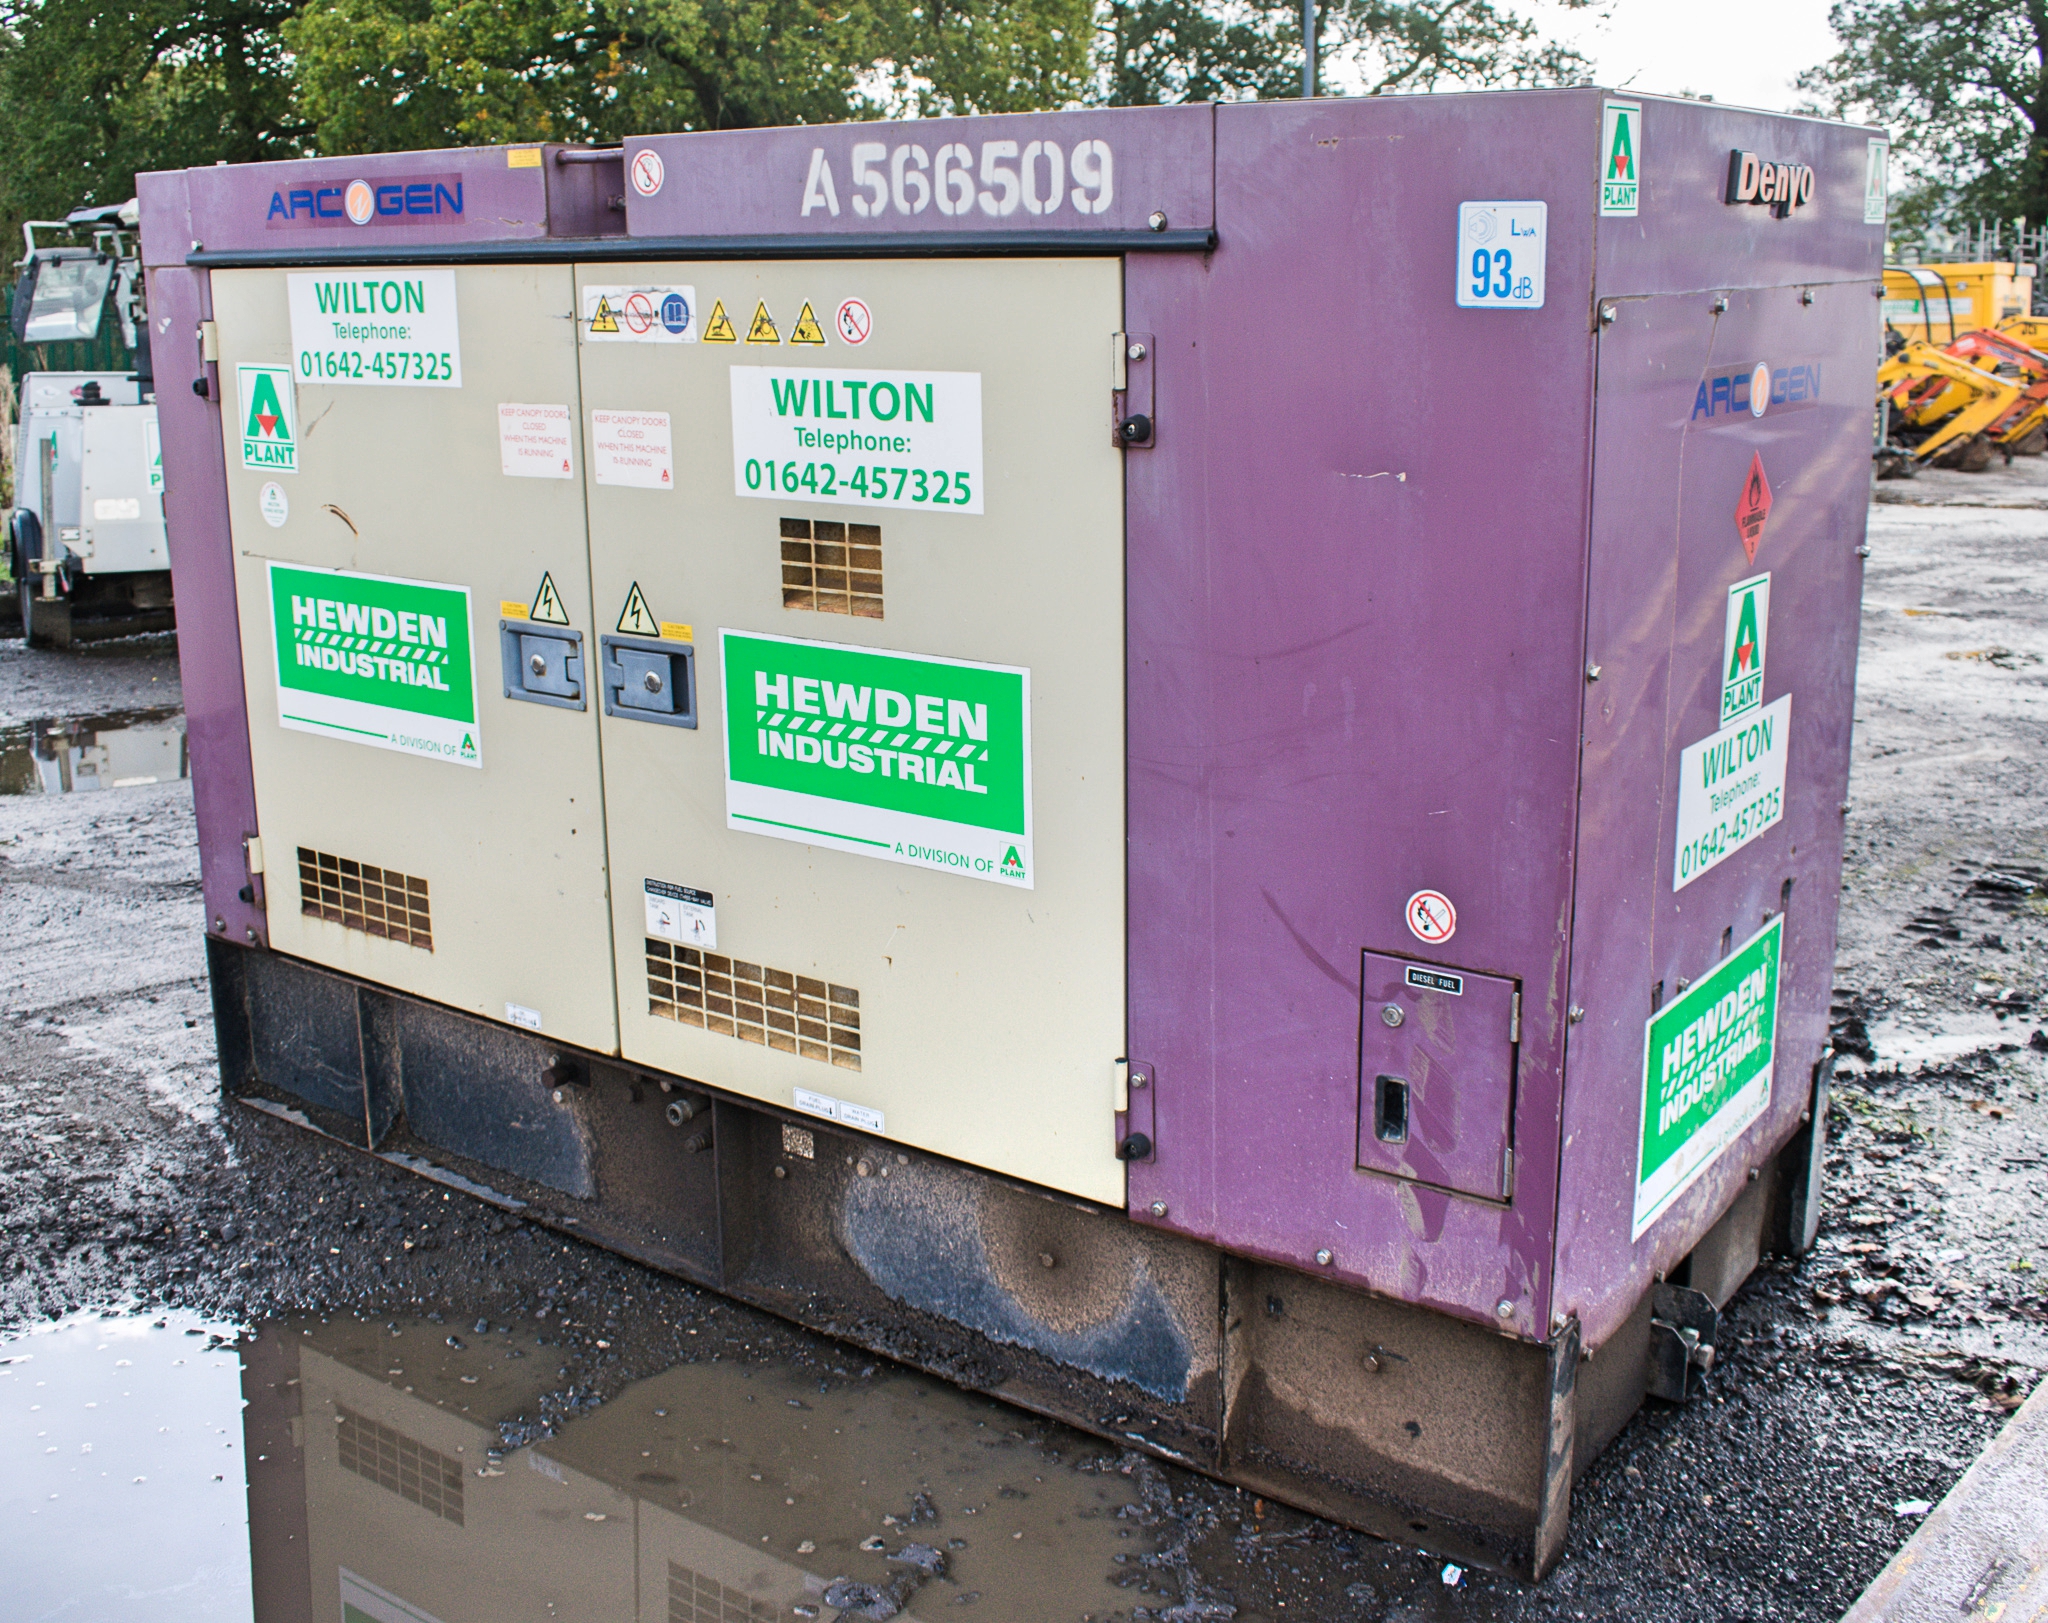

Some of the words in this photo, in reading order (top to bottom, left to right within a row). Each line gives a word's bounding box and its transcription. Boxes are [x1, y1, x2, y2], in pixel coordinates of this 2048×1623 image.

[1607, 113, 1635, 179] A
[801, 148, 840, 217] A
[851, 139, 1114, 217] 566509
[1733, 151, 1815, 217] Denyo
[1604, 187, 1636, 206] PLANT
[1472, 248, 1512, 298] 93
[1513, 277, 1533, 299] dB
[315, 281, 425, 314] WILTON
[332, 322, 411, 343] Telephone:
[301, 351, 453, 380] 01642-457325
[247, 374, 290, 440] A
[501, 408, 516, 417] KEEP
[517, 409, 542, 418] CANOPY
[543, 410, 567, 419] DOORS
[771, 378, 934, 423] WILTON
[522, 422, 547, 431] CLOSED
[595, 415, 610, 424] KEEP
[612, 416, 640, 425] CANOPY
[642, 417, 667, 427] DOORS
[617, 429, 644, 439] CLOSED
[244, 443, 295, 465] PLANT
[504, 434, 523, 443] WHEN
[523, 435, 537, 444] THIS
[538, 436, 567, 446] MACHINE
[524, 448, 554, 458] RUNNING
[597, 441, 618, 451] WHEN
[619, 443, 634, 452] THIS
[635, 444, 667, 455] MACHINE
[794, 426, 911, 454] Telephone:
[619, 456, 652, 467] RUNNING
[745, 459, 971, 505] 01642-457325
[291, 594, 448, 648] HEWDEN
[1728, 590, 1760, 682] A
[295, 643, 450, 691] INDUSTRIAL
[755, 670, 988, 742] HEWDEN
[1723, 677, 1762, 716] PLANT
[391, 733, 397, 743] A
[400, 734, 441, 753] DIVISION
[443, 744, 456, 756] OF
[460, 751, 477, 760] PLANT
[1702, 715, 1774, 789] WILTON
[758, 728, 988, 795] INDUSTRIAL
[1710, 771, 1761, 815] Telephone:
[1681, 786, 1780, 880] 01642-457325
[895, 842, 904, 855] A
[909, 844, 970, 869] DIVISION
[975, 858, 994, 873] OF
[1000, 867, 1026, 879] PLANT
[1412, 972, 1435, 985] DIESEL
[1438, 978, 1455, 989] FUEL
[1661, 962, 1767, 1084] HEWDEN
[1659, 1023, 1762, 1136] INDUSTRIAL
